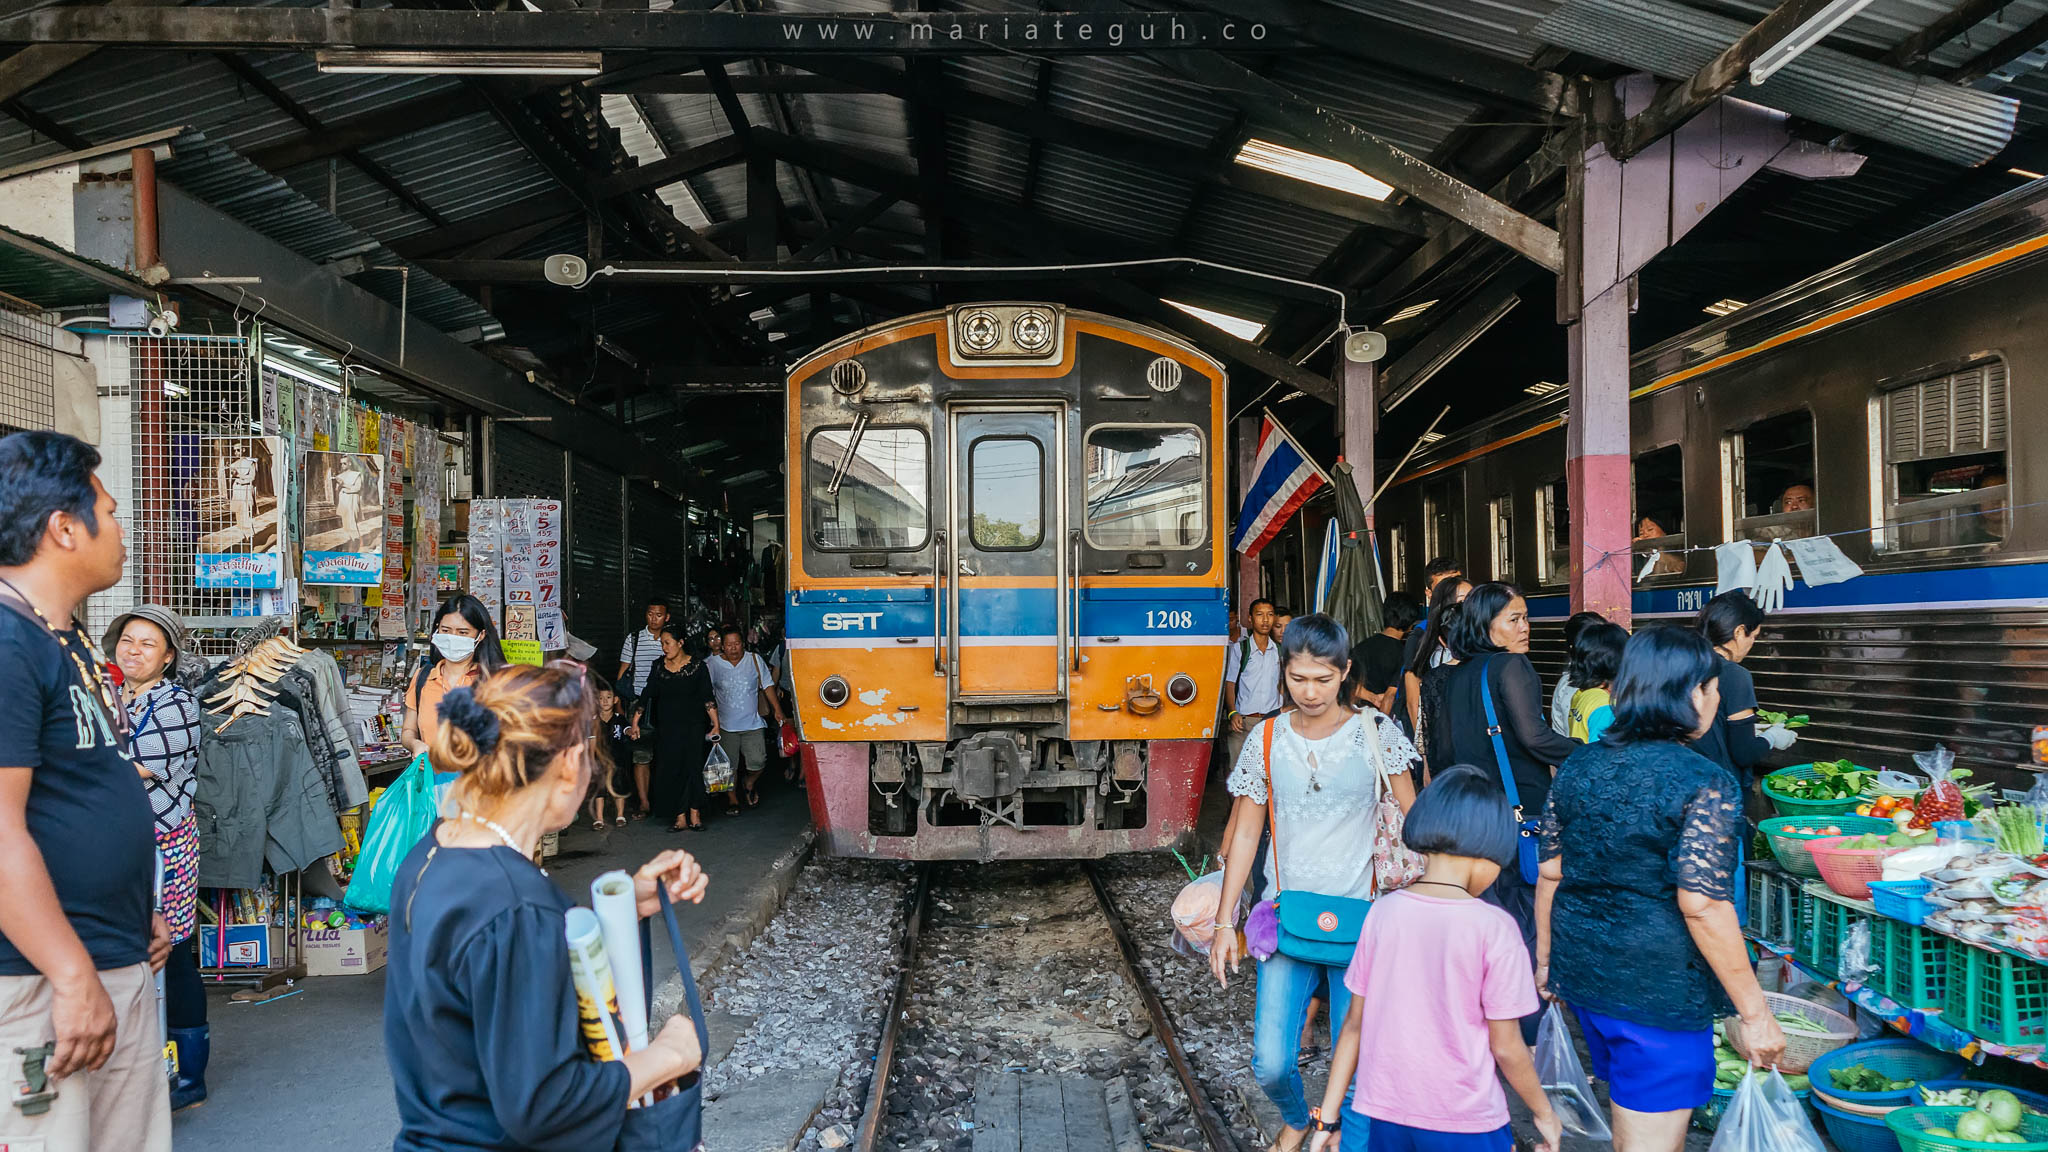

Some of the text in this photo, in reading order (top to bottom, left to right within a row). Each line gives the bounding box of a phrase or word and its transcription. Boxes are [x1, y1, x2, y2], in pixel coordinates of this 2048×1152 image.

[538, 518, 549, 529] 5
[539, 554, 551, 567] 2
[509, 590, 532, 601] 672
[540, 585, 554, 603] 7
[822, 612, 884, 631] SRT
[1145, 610, 1193, 629] 1208
[545, 626, 555, 640] 7
